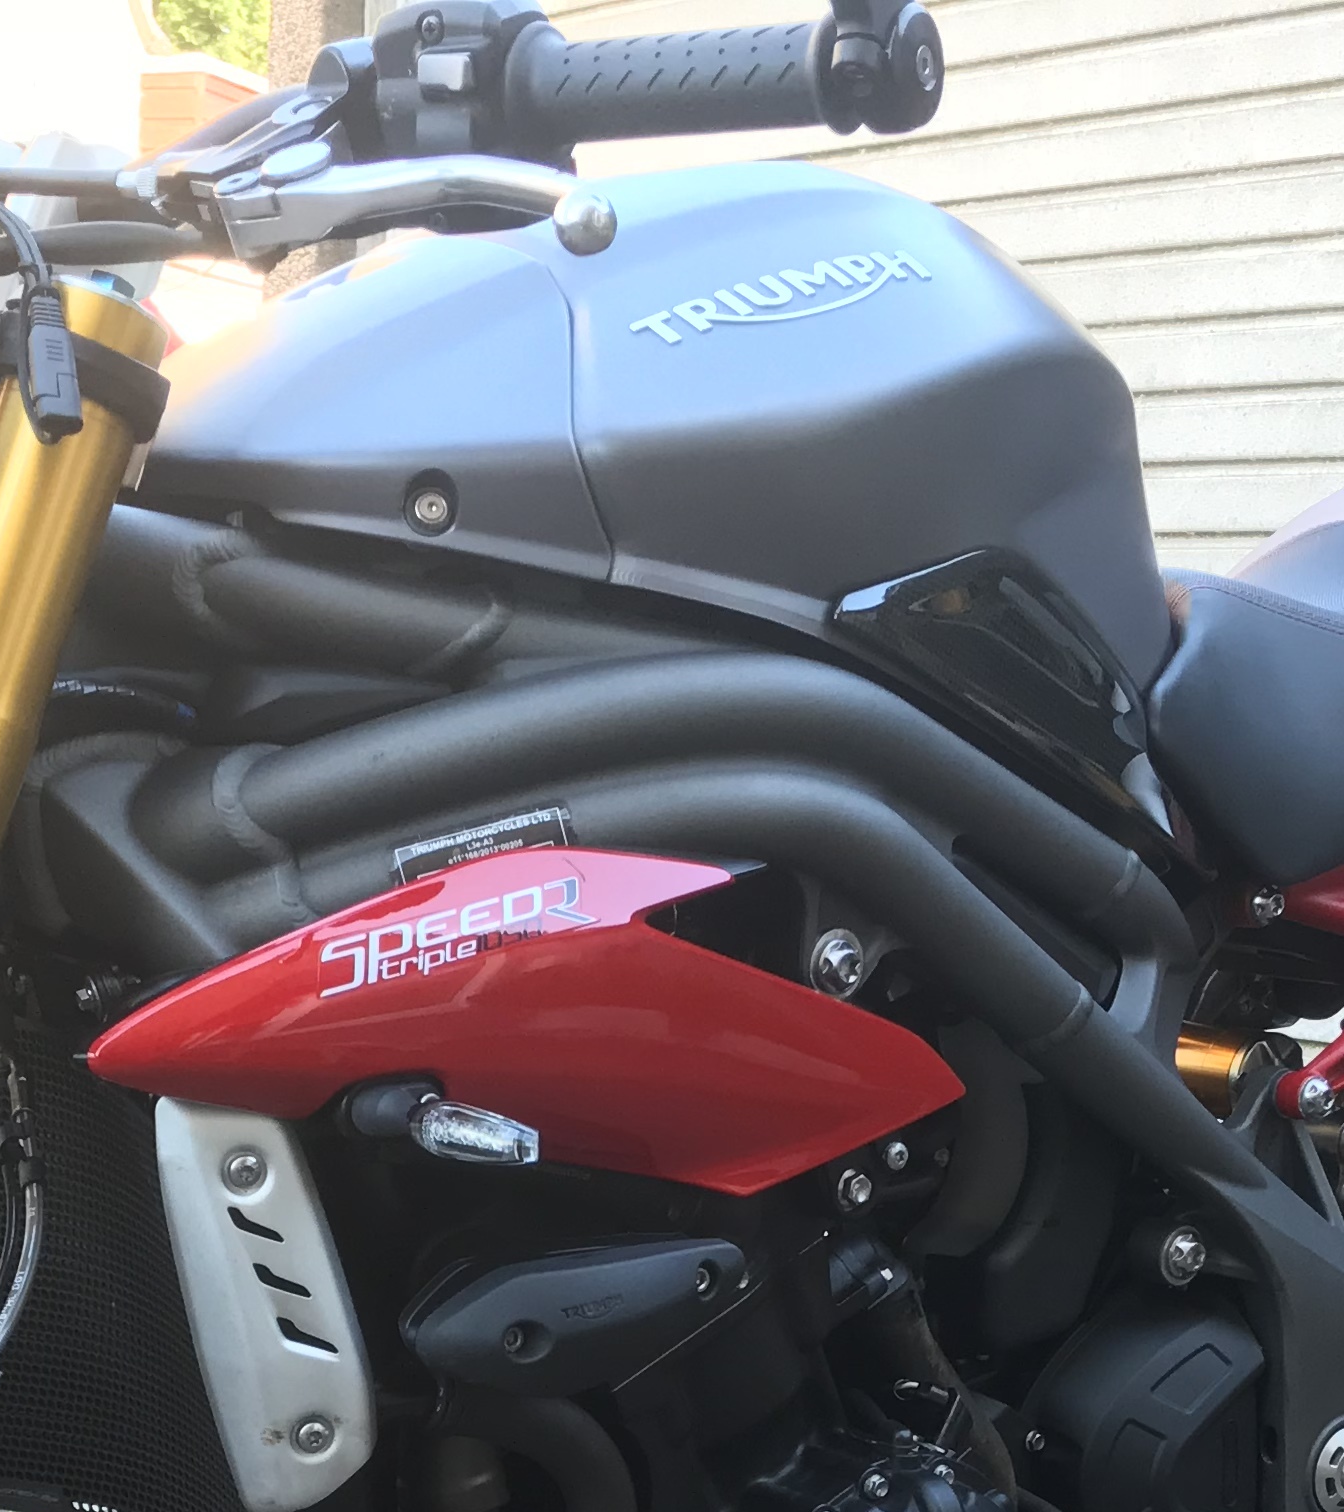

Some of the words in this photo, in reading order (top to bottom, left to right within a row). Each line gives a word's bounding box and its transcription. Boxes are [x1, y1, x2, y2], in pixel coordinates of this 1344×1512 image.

[629, 249, 932, 345] TRIUMPH
[410, 838, 455, 856] TRIUMPH
[455, 819, 530, 845] MOTORCYCLES
[531, 812, 552, 825] LTD
[320, 885, 543, 998] SPEED
[379, 938, 477, 976] triple
